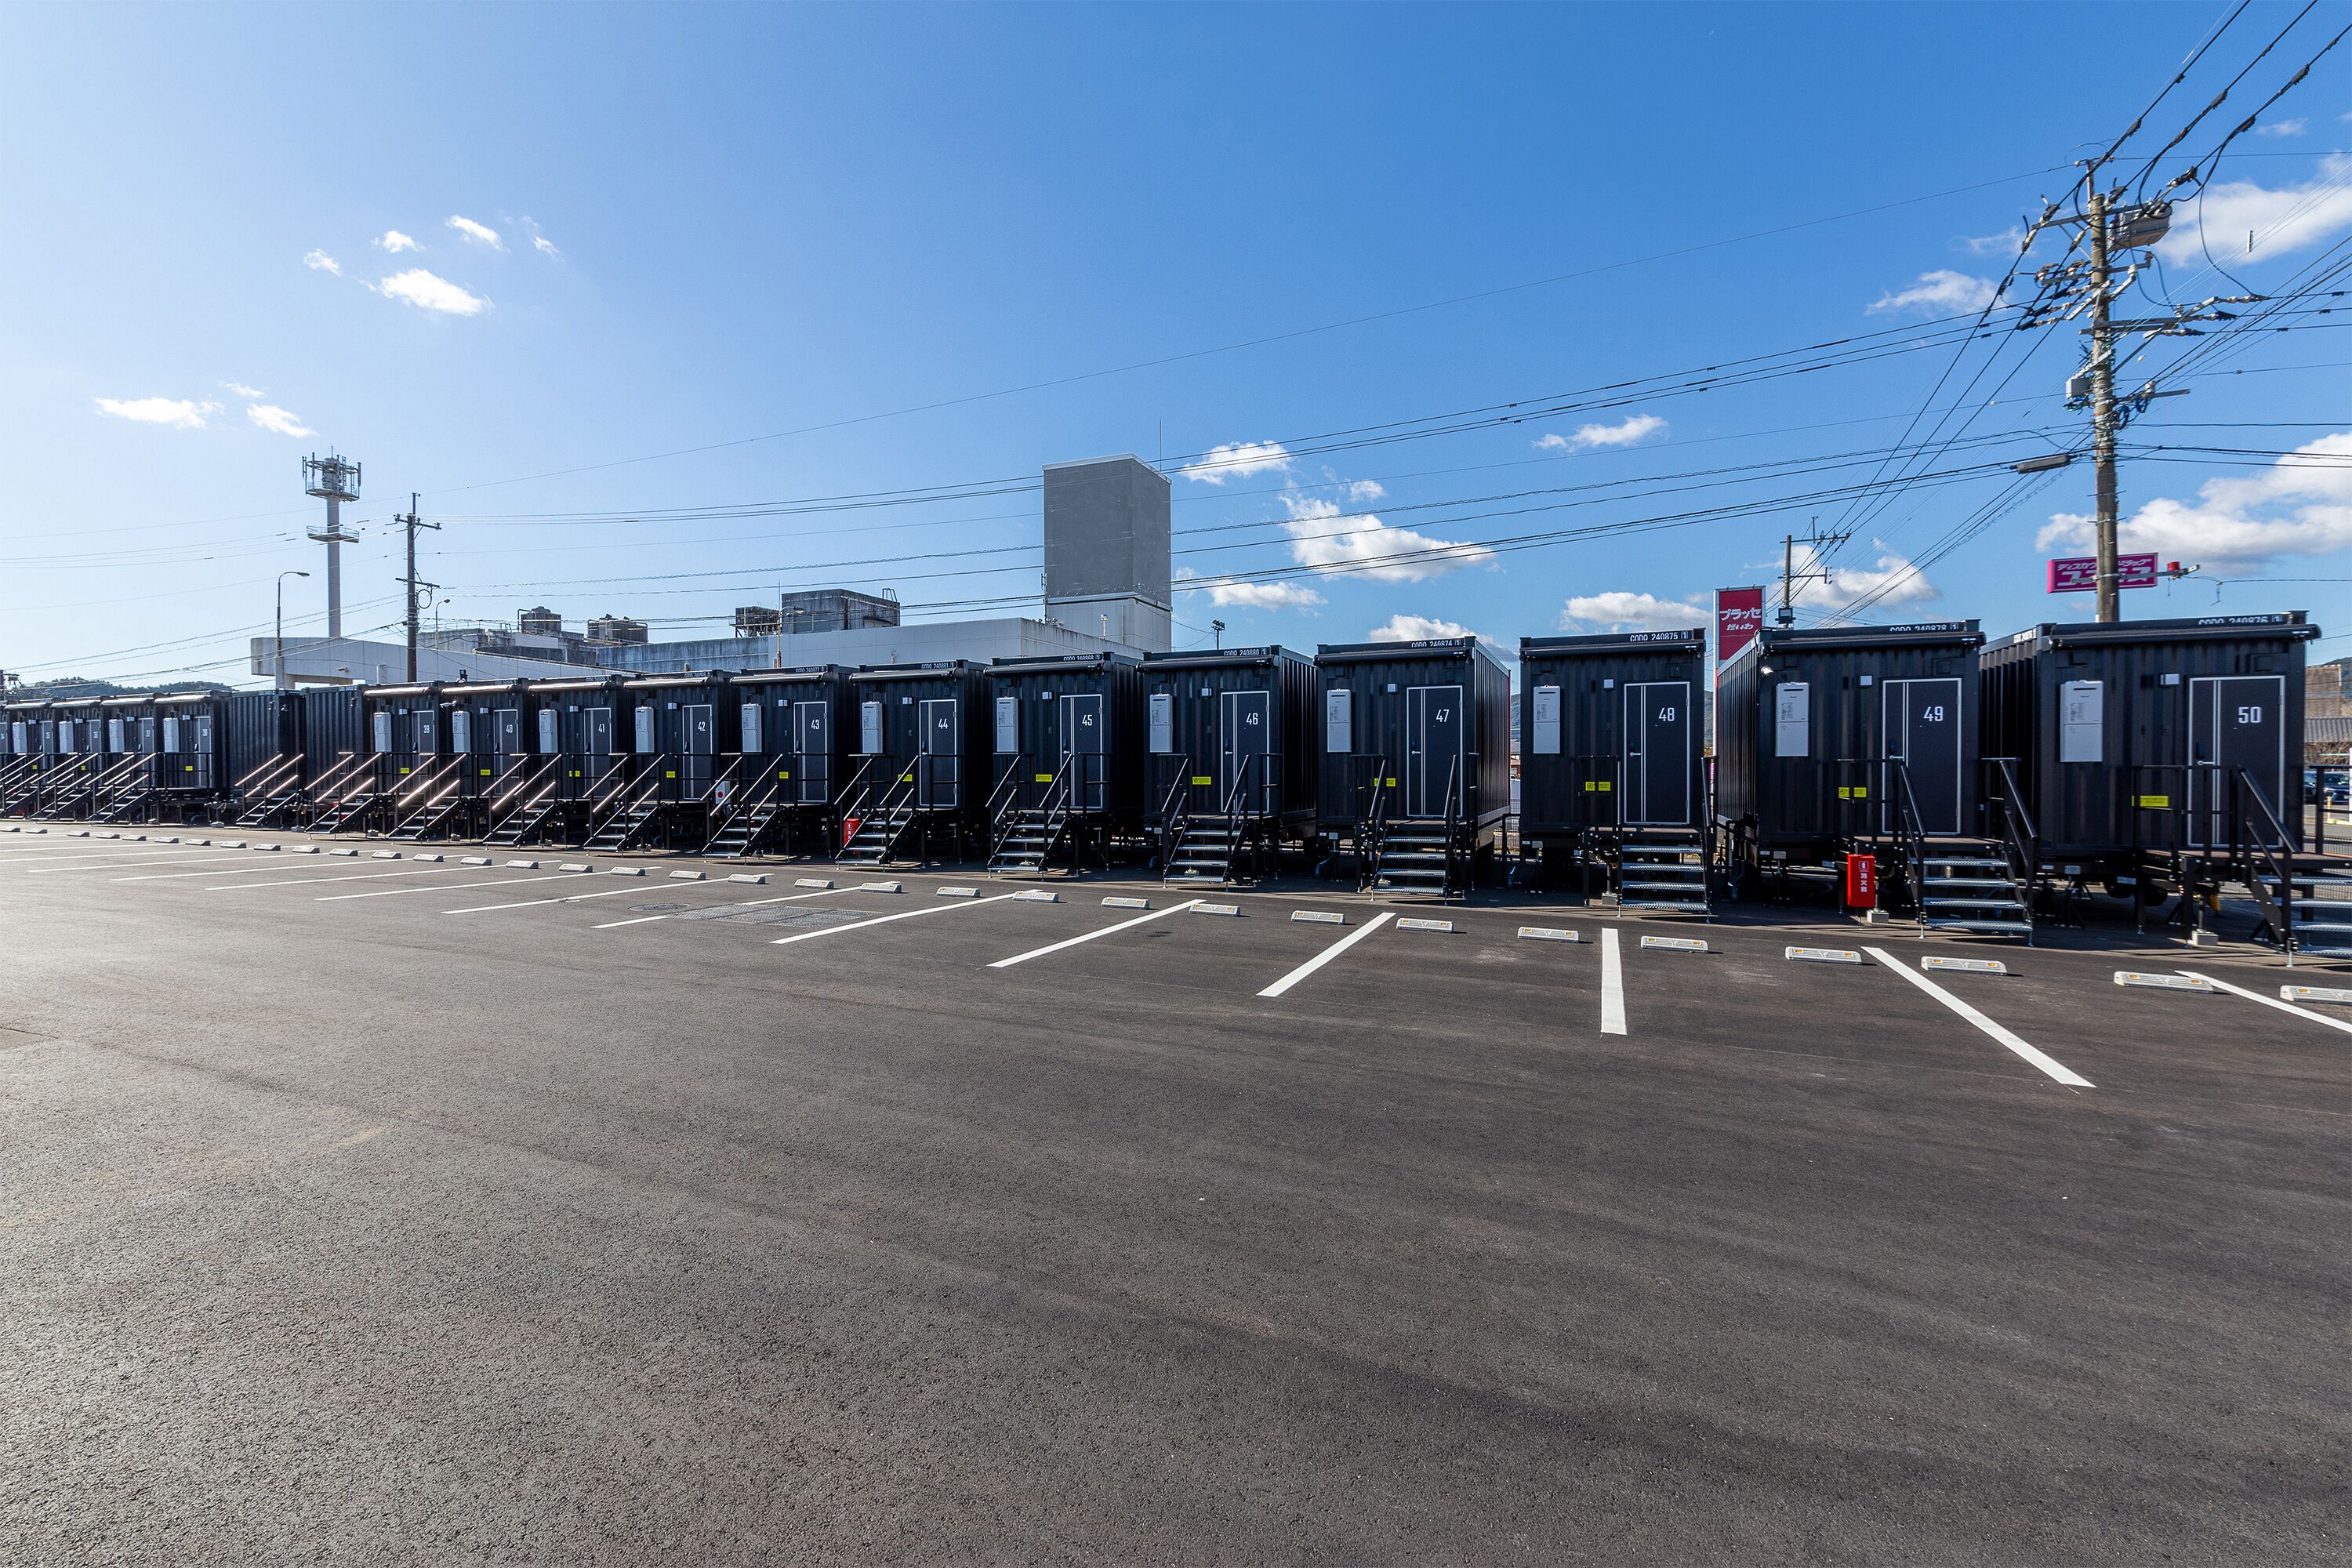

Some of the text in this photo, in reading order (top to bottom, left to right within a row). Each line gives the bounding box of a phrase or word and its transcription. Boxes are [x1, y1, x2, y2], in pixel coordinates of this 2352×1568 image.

[1719, 607, 1762, 621] プラッセ
[1651, 632, 1678, 641] 240875
[1246, 713, 1258, 725] 46
[1436, 709, 1450, 722] 47
[1658, 707, 1675, 722] 48
[1923, 706, 1944, 722] 49
[2238, 706, 2261, 724] 50
[811, 719, 820, 730] 43
[938, 718, 949, 729] 44
[1082, 714, 1093, 726] 45
[423, 724, 430, 734] 39
[506, 724, 513, 734] 40
[598, 723, 605, 733] 41
[698, 721, 706, 731] 42
